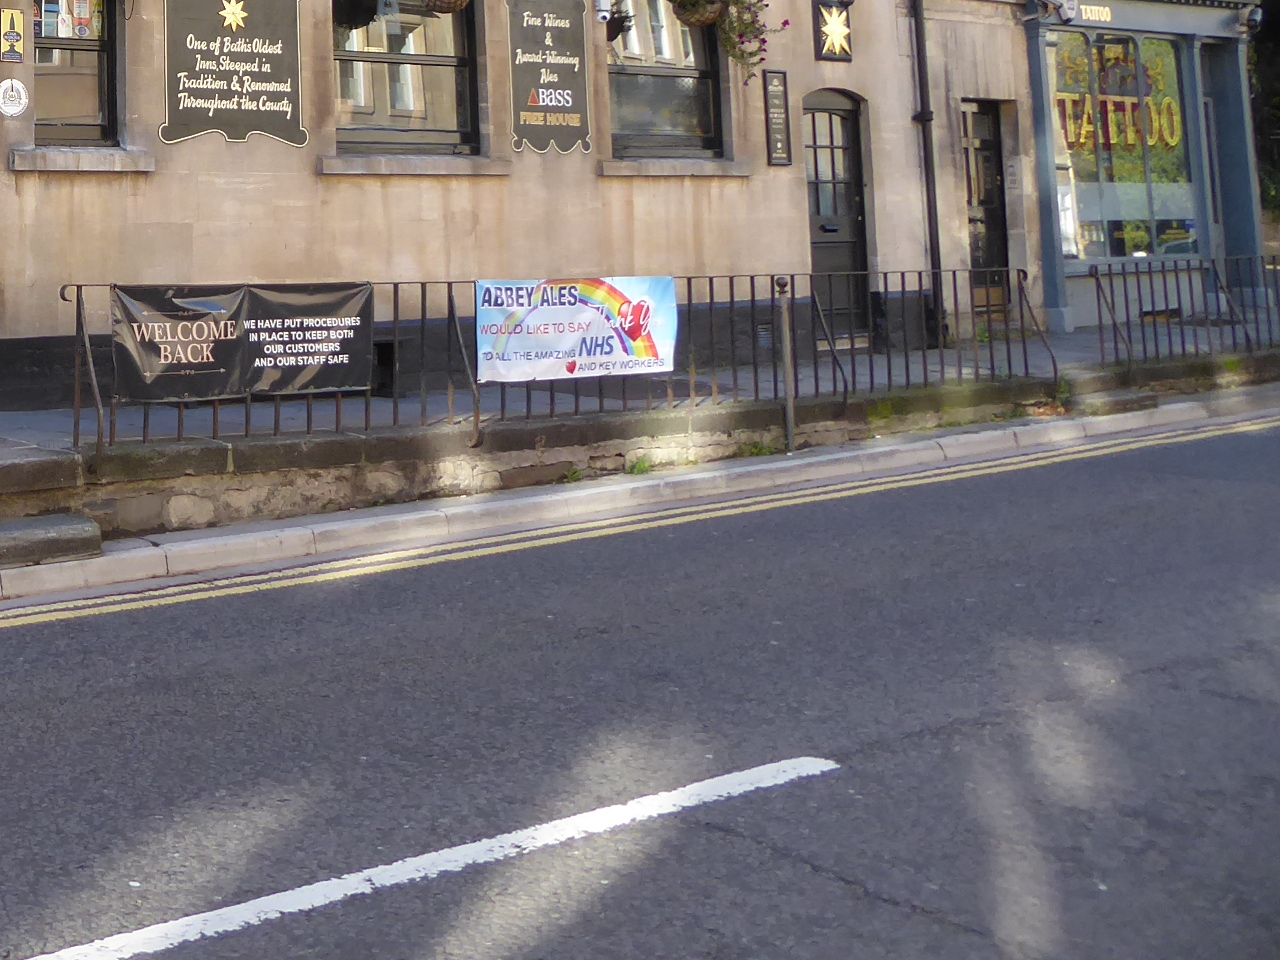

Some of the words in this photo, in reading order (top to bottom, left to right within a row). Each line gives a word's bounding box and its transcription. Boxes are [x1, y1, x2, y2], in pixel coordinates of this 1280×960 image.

[523, 11, 542, 28] Fine
[543, 13, 571, 28] Wines
[1080, 4, 1112, 22] TATTOO
[186, 33, 207, 50] One
[209, 37, 221, 55] of
[252, 39, 283, 54] Oldest
[544, 31, 553, 47] &
[219, 56, 259, 76] Steeped
[261, 58, 271, 73] in
[515, 48, 580, 72] Award-Winning
[177, 71, 227, 90] Tradition
[230, 75, 241, 91] &
[242, 76, 292, 93] Renowned
[539, 68, 559, 84] Ales
[177, 93, 239, 117] Throughout
[240, 96, 258, 111] the
[258, 96, 292, 120] County
[520, 111, 545, 126] FREE
[546, 112, 582, 127] HOUSE
[1055, 92, 1182, 147] TATTOO
[481, 286, 535, 307] ABBEY
[539, 285, 578, 307] ALES
[131, 320, 237, 343] WELCOME
[243, 319, 256, 329] WE
[257, 319, 283, 329] HAVE
[284, 318, 302, 328] PUT
[303, 316, 361, 328] PROCEDURES
[480, 323, 523, 335] WOULD
[526, 323, 549, 334] LIKE
[551, 322, 565, 333] TO
[568, 321, 591, 333] SAY
[249, 332, 258, 342] IN
[260, 331, 289, 341] PLACE
[290, 331, 303, 341] TO
[305, 330, 328, 340] KEEP
[329, 329, 354, 339] BOTH
[158, 343, 215, 364] BACK
[264, 344, 284, 354] OUR
[285, 342, 341, 353] CUSTOMERS
[482, 351, 493, 361] TO
[495, 352, 511, 361] ALL
[513, 351, 532, 361] THE
[534, 349, 576, 360] AMAZING
[578, 335, 615, 357] NHS
[254, 357, 274, 367] AND
[276, 356, 296, 367] OUR
[297, 355, 326, 365] STAFF
[327, 354, 349, 364] SAFE
[578, 362, 596, 372] AND
[599, 361, 617, 371] KEY
[619, 358, 665, 369] WORKERS
